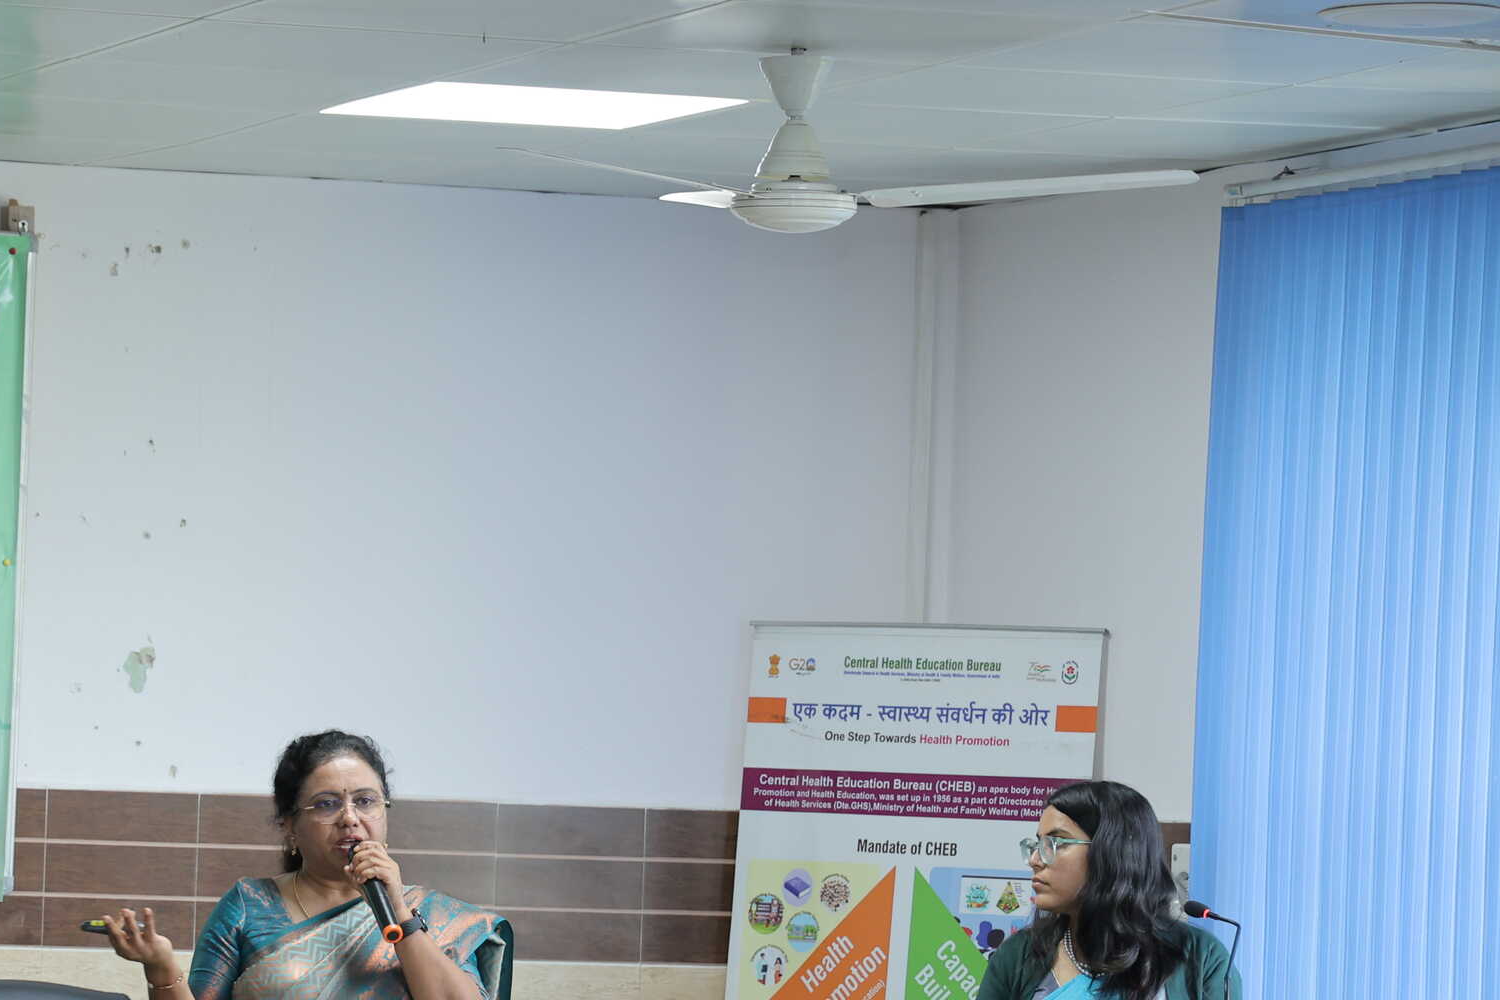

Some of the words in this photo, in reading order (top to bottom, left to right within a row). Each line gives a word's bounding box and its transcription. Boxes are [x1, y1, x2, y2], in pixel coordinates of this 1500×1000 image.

[843, 655, 879, 669] Central
[881, 657, 913, 670] Health
[915, 658, 963, 671] Education
[966, 659, 1002, 672] Bureau
[792, 703, 819, 722] एक
[822, 703, 863, 722] कदम
[877, 705, 932, 723] स्वास्थ्य
[935, 701, 988, 725] संवर्धन
[991, 702, 1014, 726] की
[1018, 703, 1051, 726] ओर
[824, 730, 845, 741] One
[847, 731, 871, 744] Step
[874, 732, 917, 744] Towards
[919, 734, 952, 744] Health
[955, 735, 1010, 747] Promotion
[759, 774, 799, 786] Central
[801, 775, 834, 788] Health
[836, 776, 890, 790] Education
[893, 778, 933, 791] Bureau
[935, 779, 976, 795] (CHEB)
[989, 786, 1009, 794] apex
[1011, 785, 1030, 796] body
[1032, 786, 1045, 795] for
[753, 787, 795, 797] Promotion
[796, 789, 810, 798] and
[811, 789, 834, 798] Health
[836, 790, 877, 801] Education,
[896, 793, 909, 801] set
[910, 795, 921, 804] up
[922, 794, 931, 802] in
[932, 794, 951, 803] 1956
[970, 796, 987, 806] part
[988, 796, 998, 804] of
[999, 797, 1043, 807] Directorate
[764, 798, 773, 807] of
[774, 798, 800, 808] Health
[801, 799, 832, 809] Services
[906, 803, 915, 812] of
[916, 804, 941, 813] Health
[943, 805, 958, 814] and
[960, 806, 986, 816] Family
[988, 807, 1019, 816] Welfare
[857, 838, 907, 855] Mandate
[911, 841, 922, 855] of
[925, 841, 958, 857] CHEB
[800, 935, 855, 993] Health
